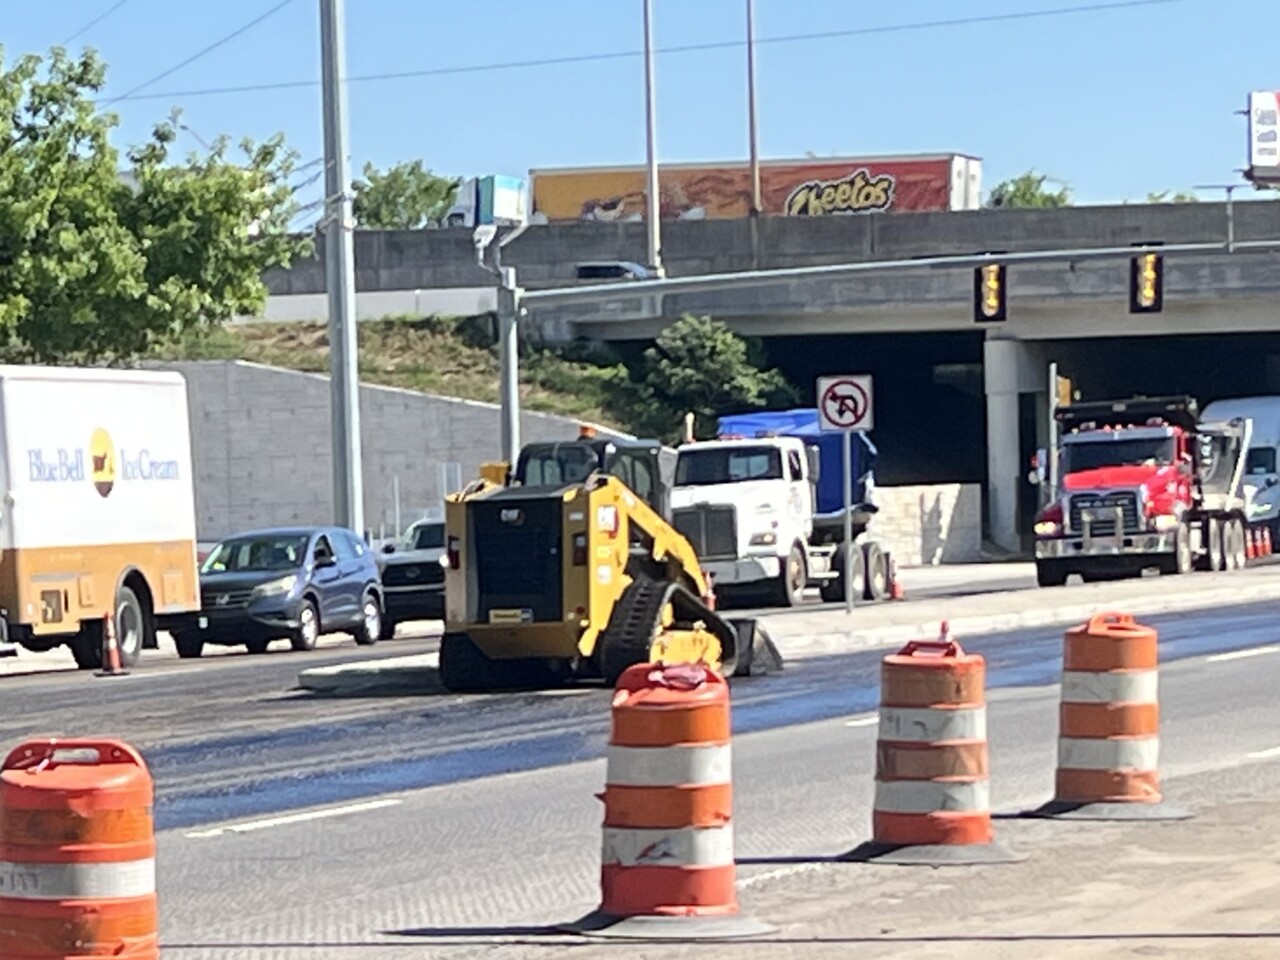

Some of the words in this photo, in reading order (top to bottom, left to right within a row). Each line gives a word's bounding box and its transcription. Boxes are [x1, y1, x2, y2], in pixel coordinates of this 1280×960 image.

[788, 170, 891, 216] Cheetos
[27, 448, 58, 482] Blue
[58, 448, 84, 482] Bell
[120, 448, 139, 480] Ice
[139, 448, 179, 480] Cream
